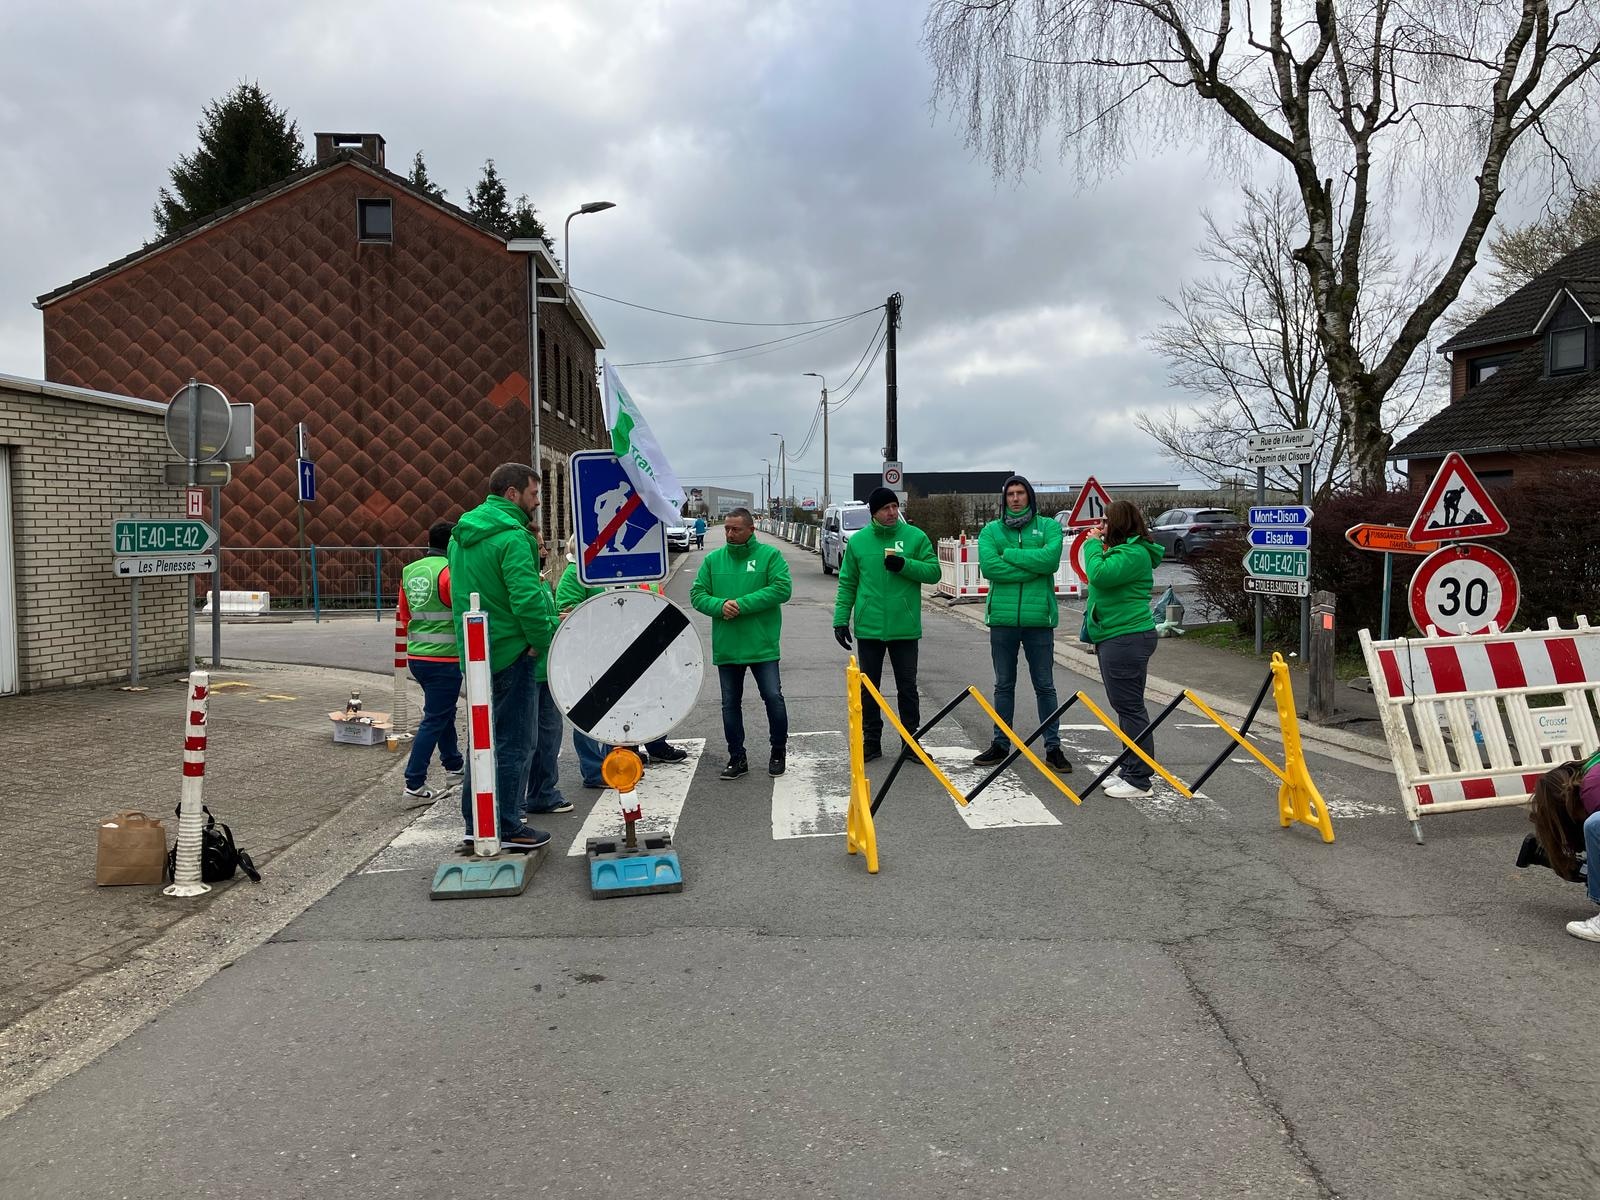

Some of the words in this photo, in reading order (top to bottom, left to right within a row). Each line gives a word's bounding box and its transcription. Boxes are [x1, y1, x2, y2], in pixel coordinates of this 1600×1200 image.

[1260, 437, 1272, 446] Rue
[1272, 436, 1280, 445] de
[1281, 434, 1304, 444] l'Avenir
[631, 444, 656, 482] Tran
[1254, 454, 1276, 464] Chemin
[192, 494, 200, 512] H
[1254, 510, 1298, 522] Mont-Dison
[139, 526, 200, 548] E40-E42
[1266, 532, 1294, 544] Elsaute
[138, 560, 153, 573] Les
[156, 560, 196, 572] Plenesses
[1254, 554, 1292, 572] E40-E42
[1438, 577, 1488, 616] 30
